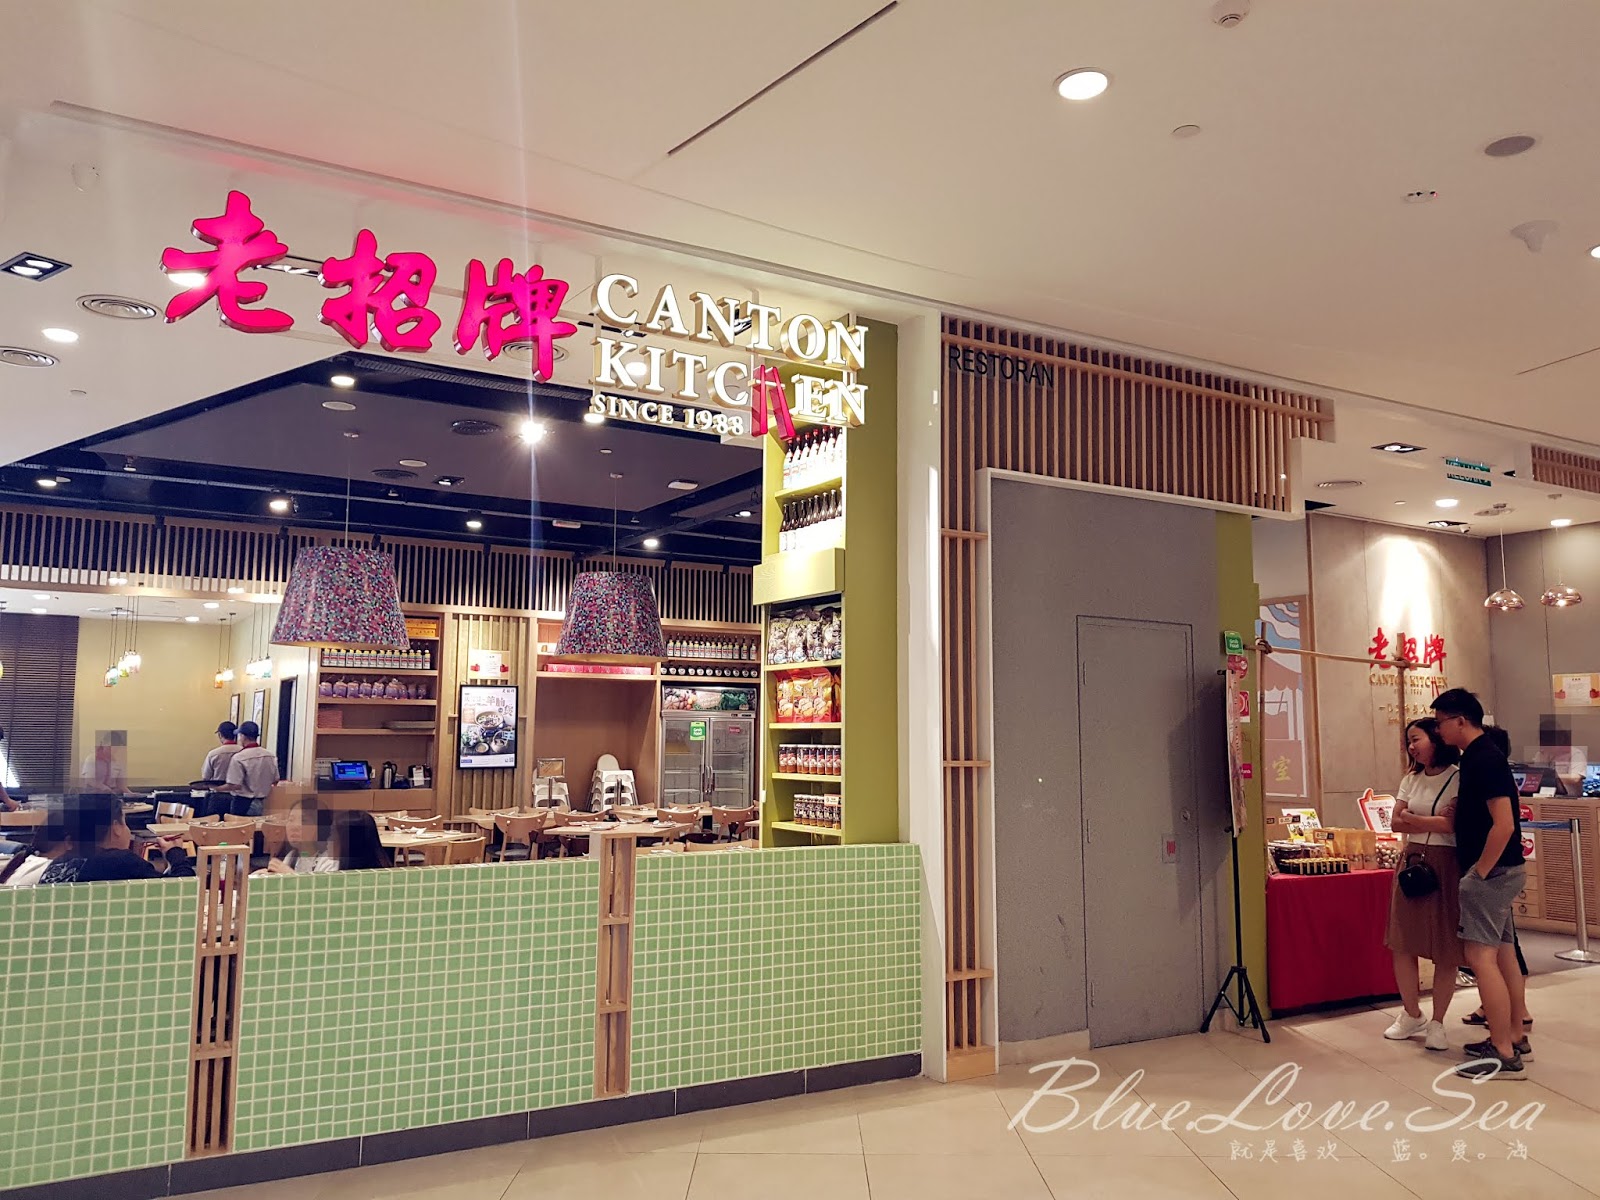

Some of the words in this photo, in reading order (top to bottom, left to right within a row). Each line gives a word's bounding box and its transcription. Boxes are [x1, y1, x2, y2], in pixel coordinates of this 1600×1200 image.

[161, 190, 578, 385] 老招牌
[592, 273, 869, 371] CANTON
[590, 336, 869, 440] KITCHEN
[948, 345, 1054, 388] RESTORAN
[590, 393, 674, 425] SINCE
[682, 406, 744, 437] 1988
[1368, 627, 1447, 674] 老招牌
